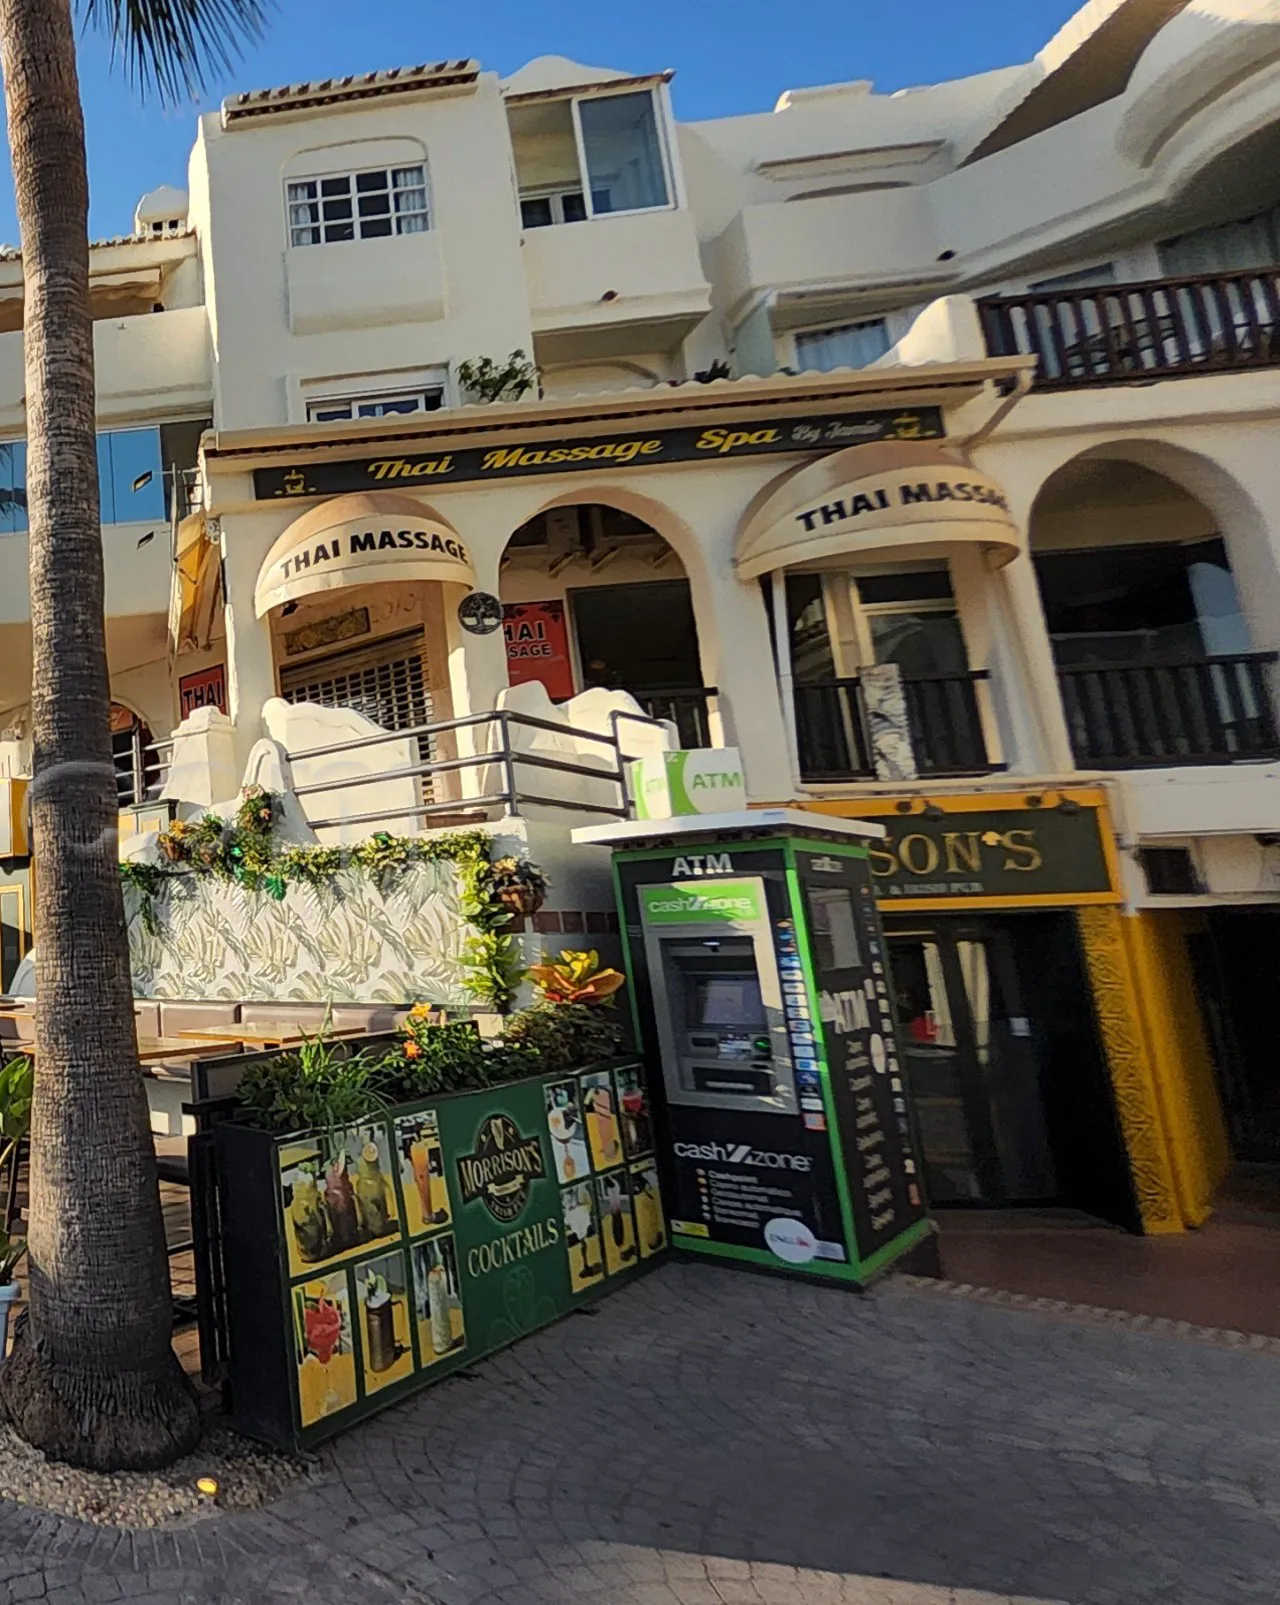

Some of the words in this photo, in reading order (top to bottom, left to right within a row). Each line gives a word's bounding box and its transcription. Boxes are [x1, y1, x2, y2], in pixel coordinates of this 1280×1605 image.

[368, 455, 455, 481] Thai
[480, 439, 663, 472] Massage
[695, 427, 782, 453] Spa
[795, 489, 890, 532] THAI
[281, 538, 341, 579] THAI
[349, 530, 470, 564] MASSAGE
[182, 680, 222, 712] THAI
[691, 772, 741, 790] ATM
[671, 853, 734, 876] ATM
[460, 1140, 543, 1198] MORRISON'S
[468, 1218, 559, 1278] COCKTAILS
